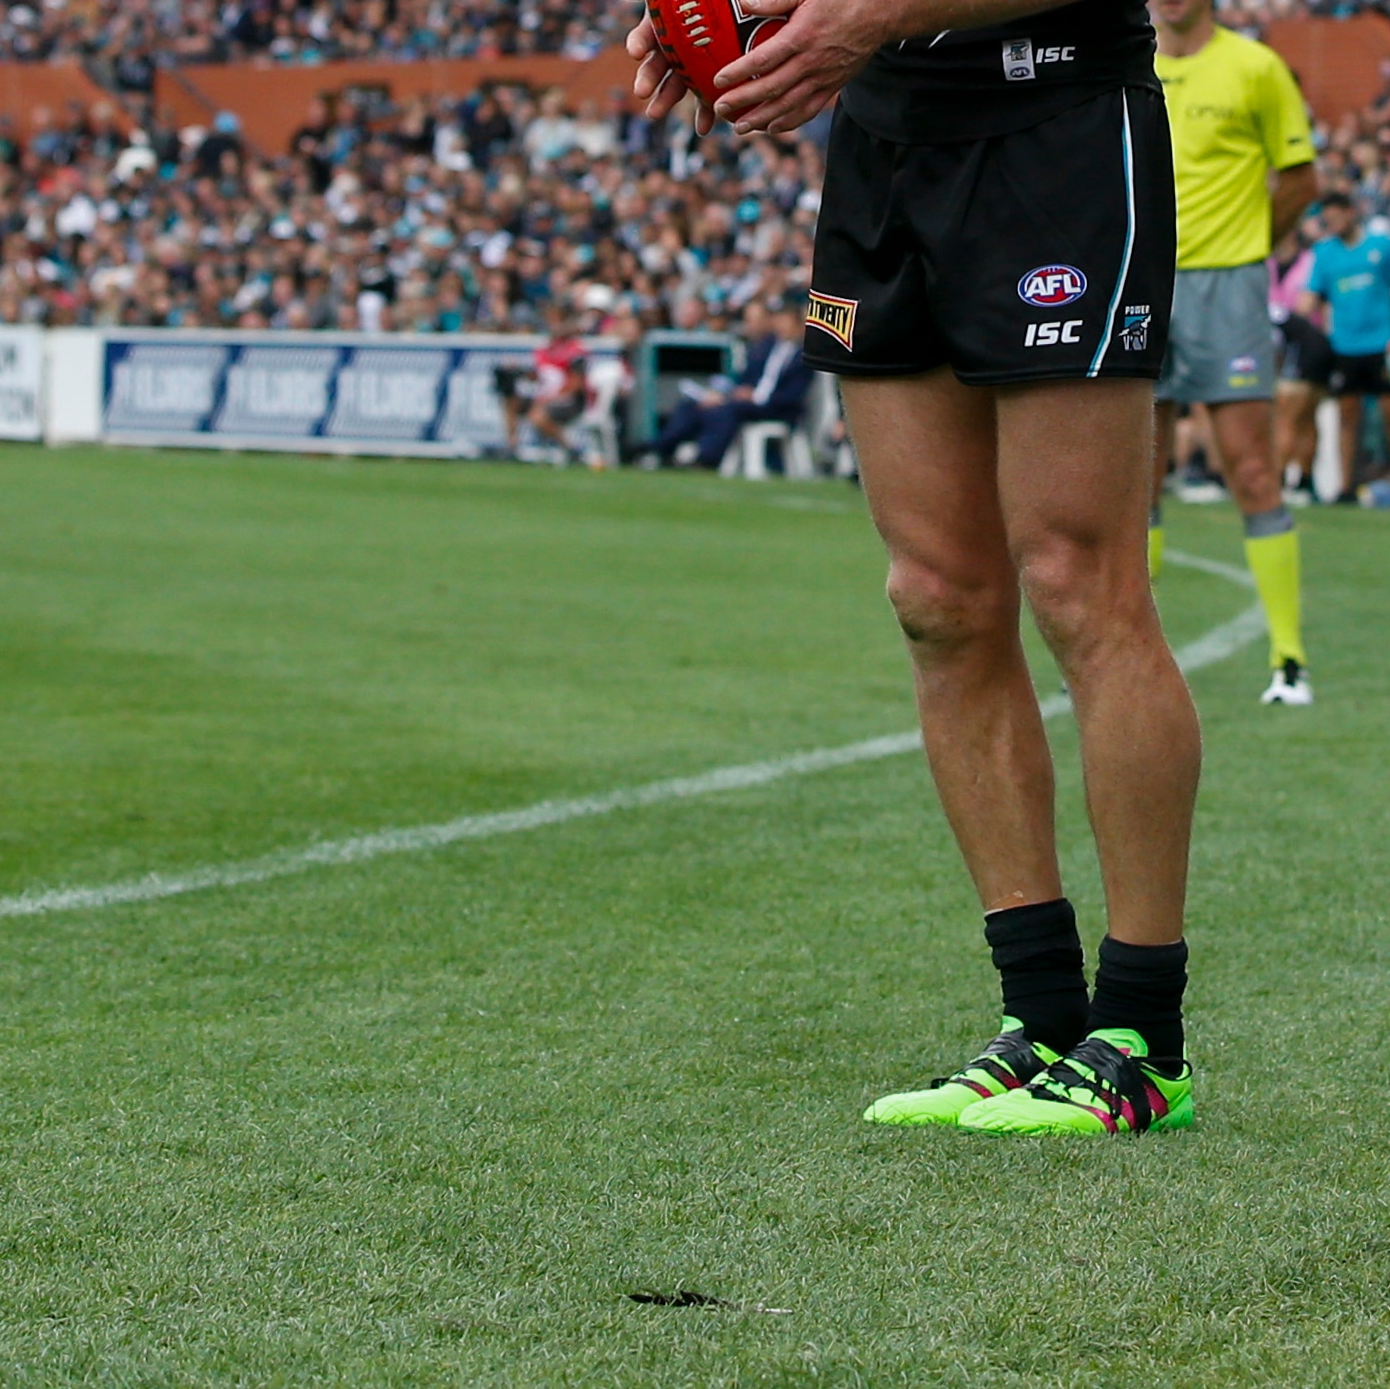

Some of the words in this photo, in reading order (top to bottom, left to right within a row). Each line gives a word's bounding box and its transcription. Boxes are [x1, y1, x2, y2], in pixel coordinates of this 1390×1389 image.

[1035, 46, 1076, 64] ISC
[1024, 273, 1082, 298] AFL
[1125, 305, 1150, 315] POWER
[1024, 320, 1084, 347] ISC
